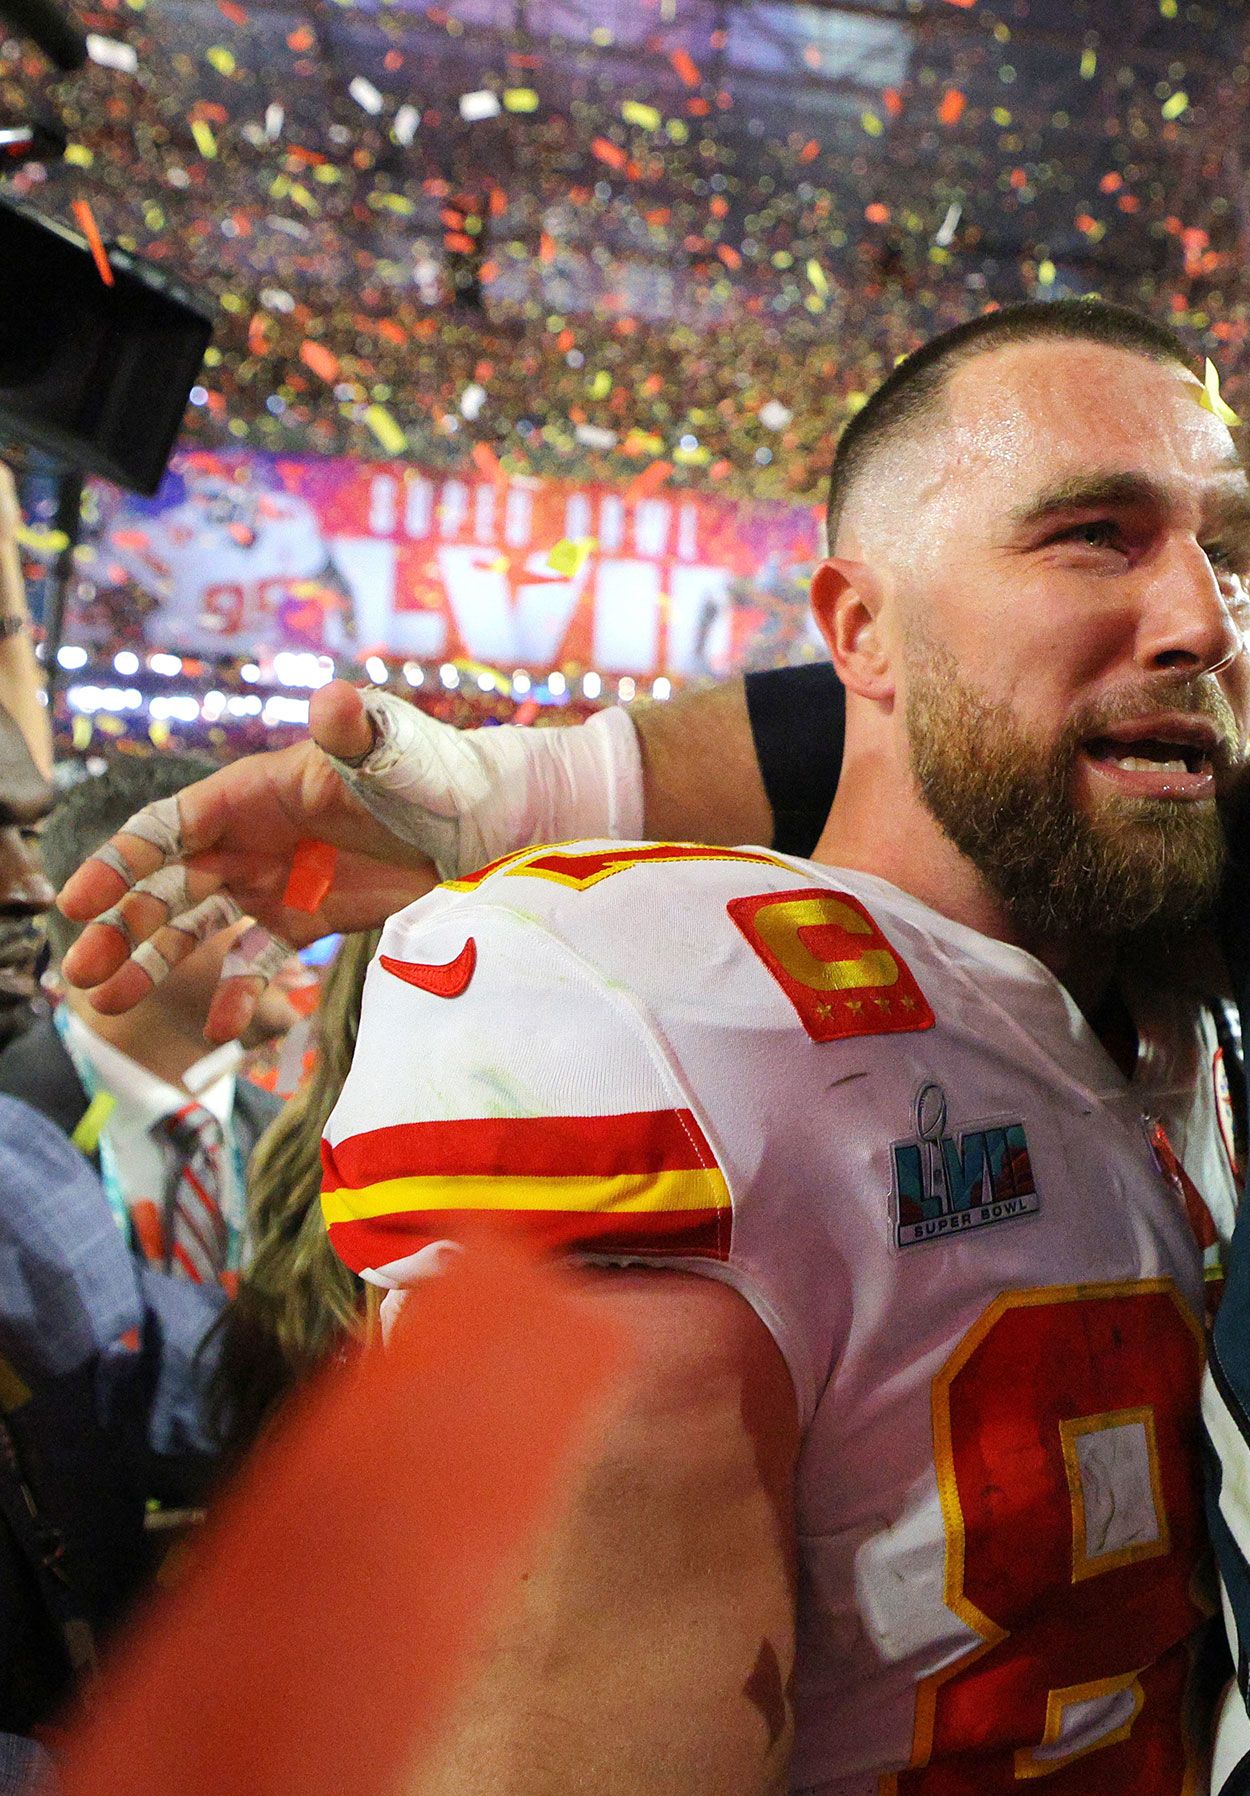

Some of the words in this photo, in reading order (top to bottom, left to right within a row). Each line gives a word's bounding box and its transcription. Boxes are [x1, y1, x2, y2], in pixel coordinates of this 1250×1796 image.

[753, 898, 900, 992] C
[895, 1123, 1036, 1227] LVII
[914, 1213, 972, 1239] SUPER
[981, 1198, 1028, 1220] BOWL
